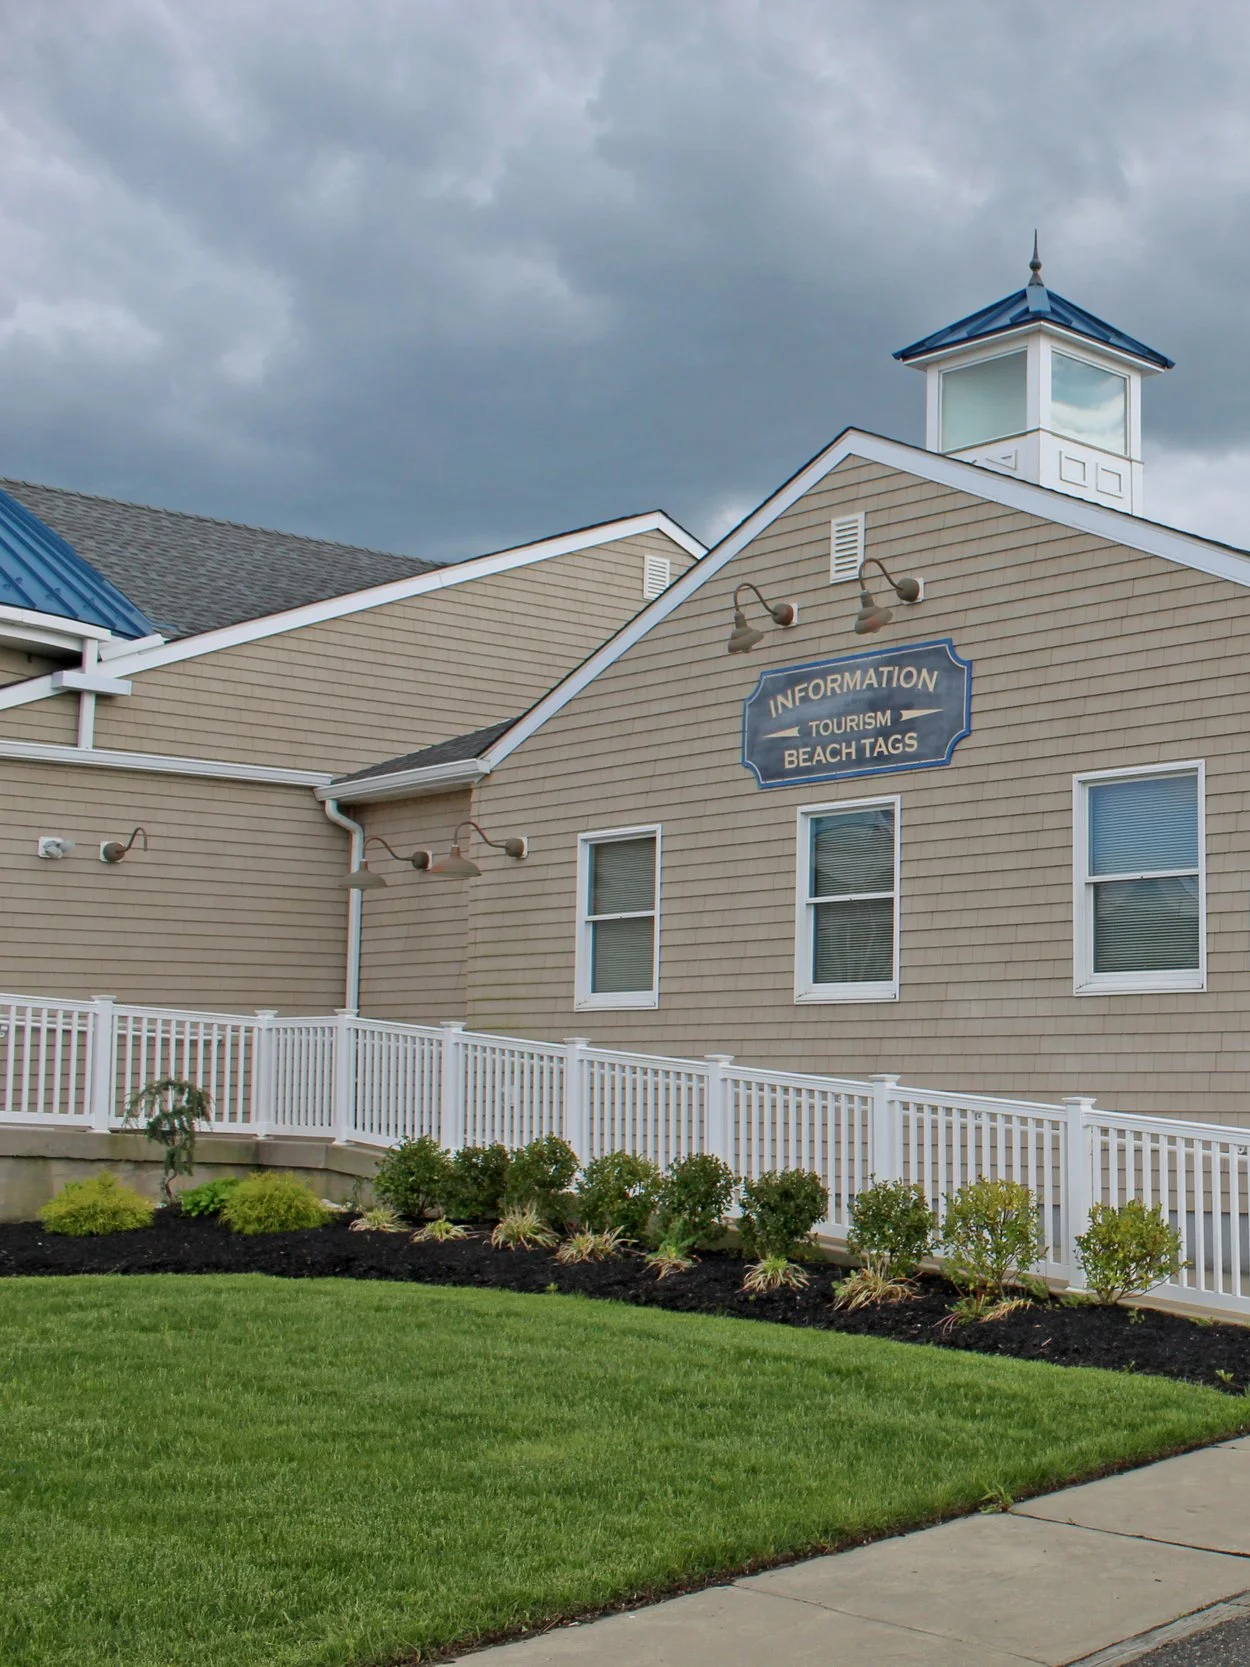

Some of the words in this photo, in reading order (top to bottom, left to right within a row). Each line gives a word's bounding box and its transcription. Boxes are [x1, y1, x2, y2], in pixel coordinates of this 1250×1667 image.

[769, 666, 939, 718] INFORMATION
[808, 709, 891, 737] TOURISM
[784, 743, 856, 769] BEACH
[861, 732, 918, 758] TAGS
